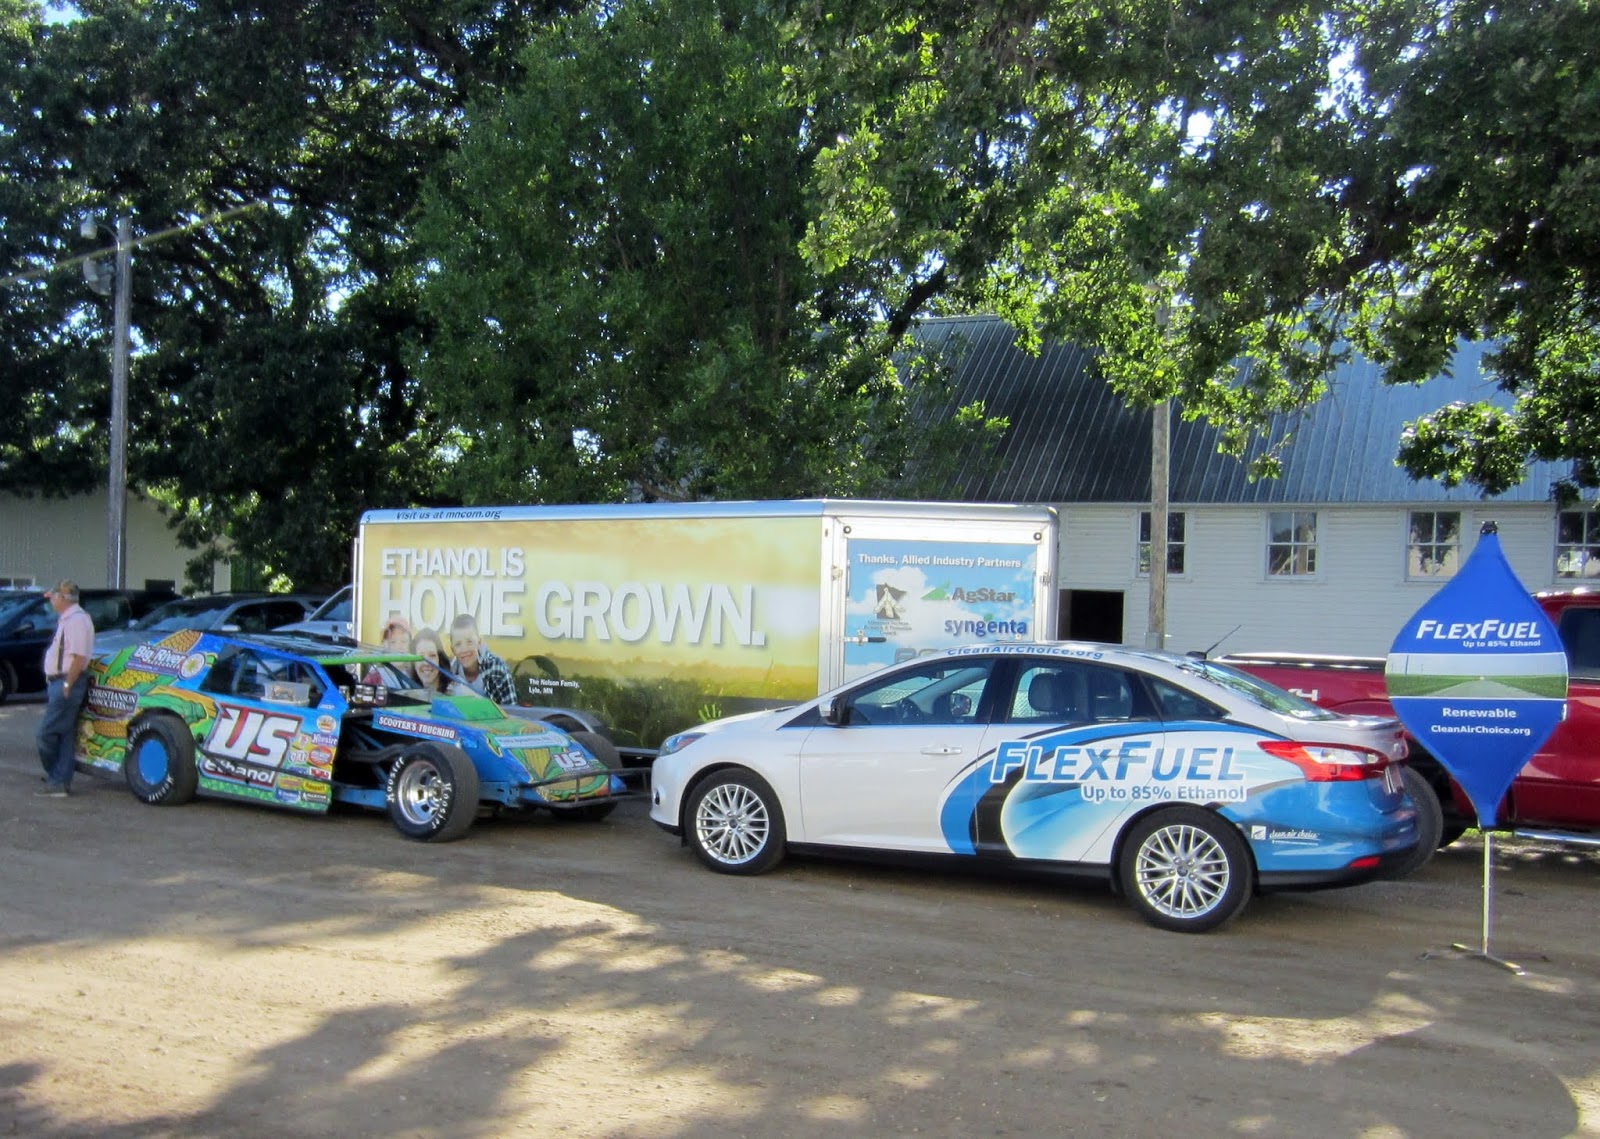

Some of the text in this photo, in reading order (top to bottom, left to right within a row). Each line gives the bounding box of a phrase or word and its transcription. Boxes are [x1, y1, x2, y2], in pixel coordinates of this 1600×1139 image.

[396, 511, 416, 520] Visit
[432, 511, 443, 519] at
[445, 510, 502, 519] mncorn.org
[381, 547, 525, 577] ETHANOL IS
[858, 554, 1022, 568] Thanks, Allied Industry Partners
[952, 587, 1016, 604] AgStar
[379, 579, 766, 646] HOME GROWN.
[944, 619, 1028, 636] syngenta
[134, 646, 151, 661] Big
[154, 649, 186, 666] River
[947, 646, 1104, 660] CleanAirChoice.org
[88, 689, 137, 704] CHRISTIANSON
[1442, 708, 1517, 718] Renewable
[378, 717, 455, 738] SCOOTER'S TRUCKING
[1431, 725, 1531, 736] CleanAirChoice.org
[207, 707, 299, 767] US
[553, 751, 587, 768] US
[1083, 786, 1244, 802] Up to 85% Ethanol
